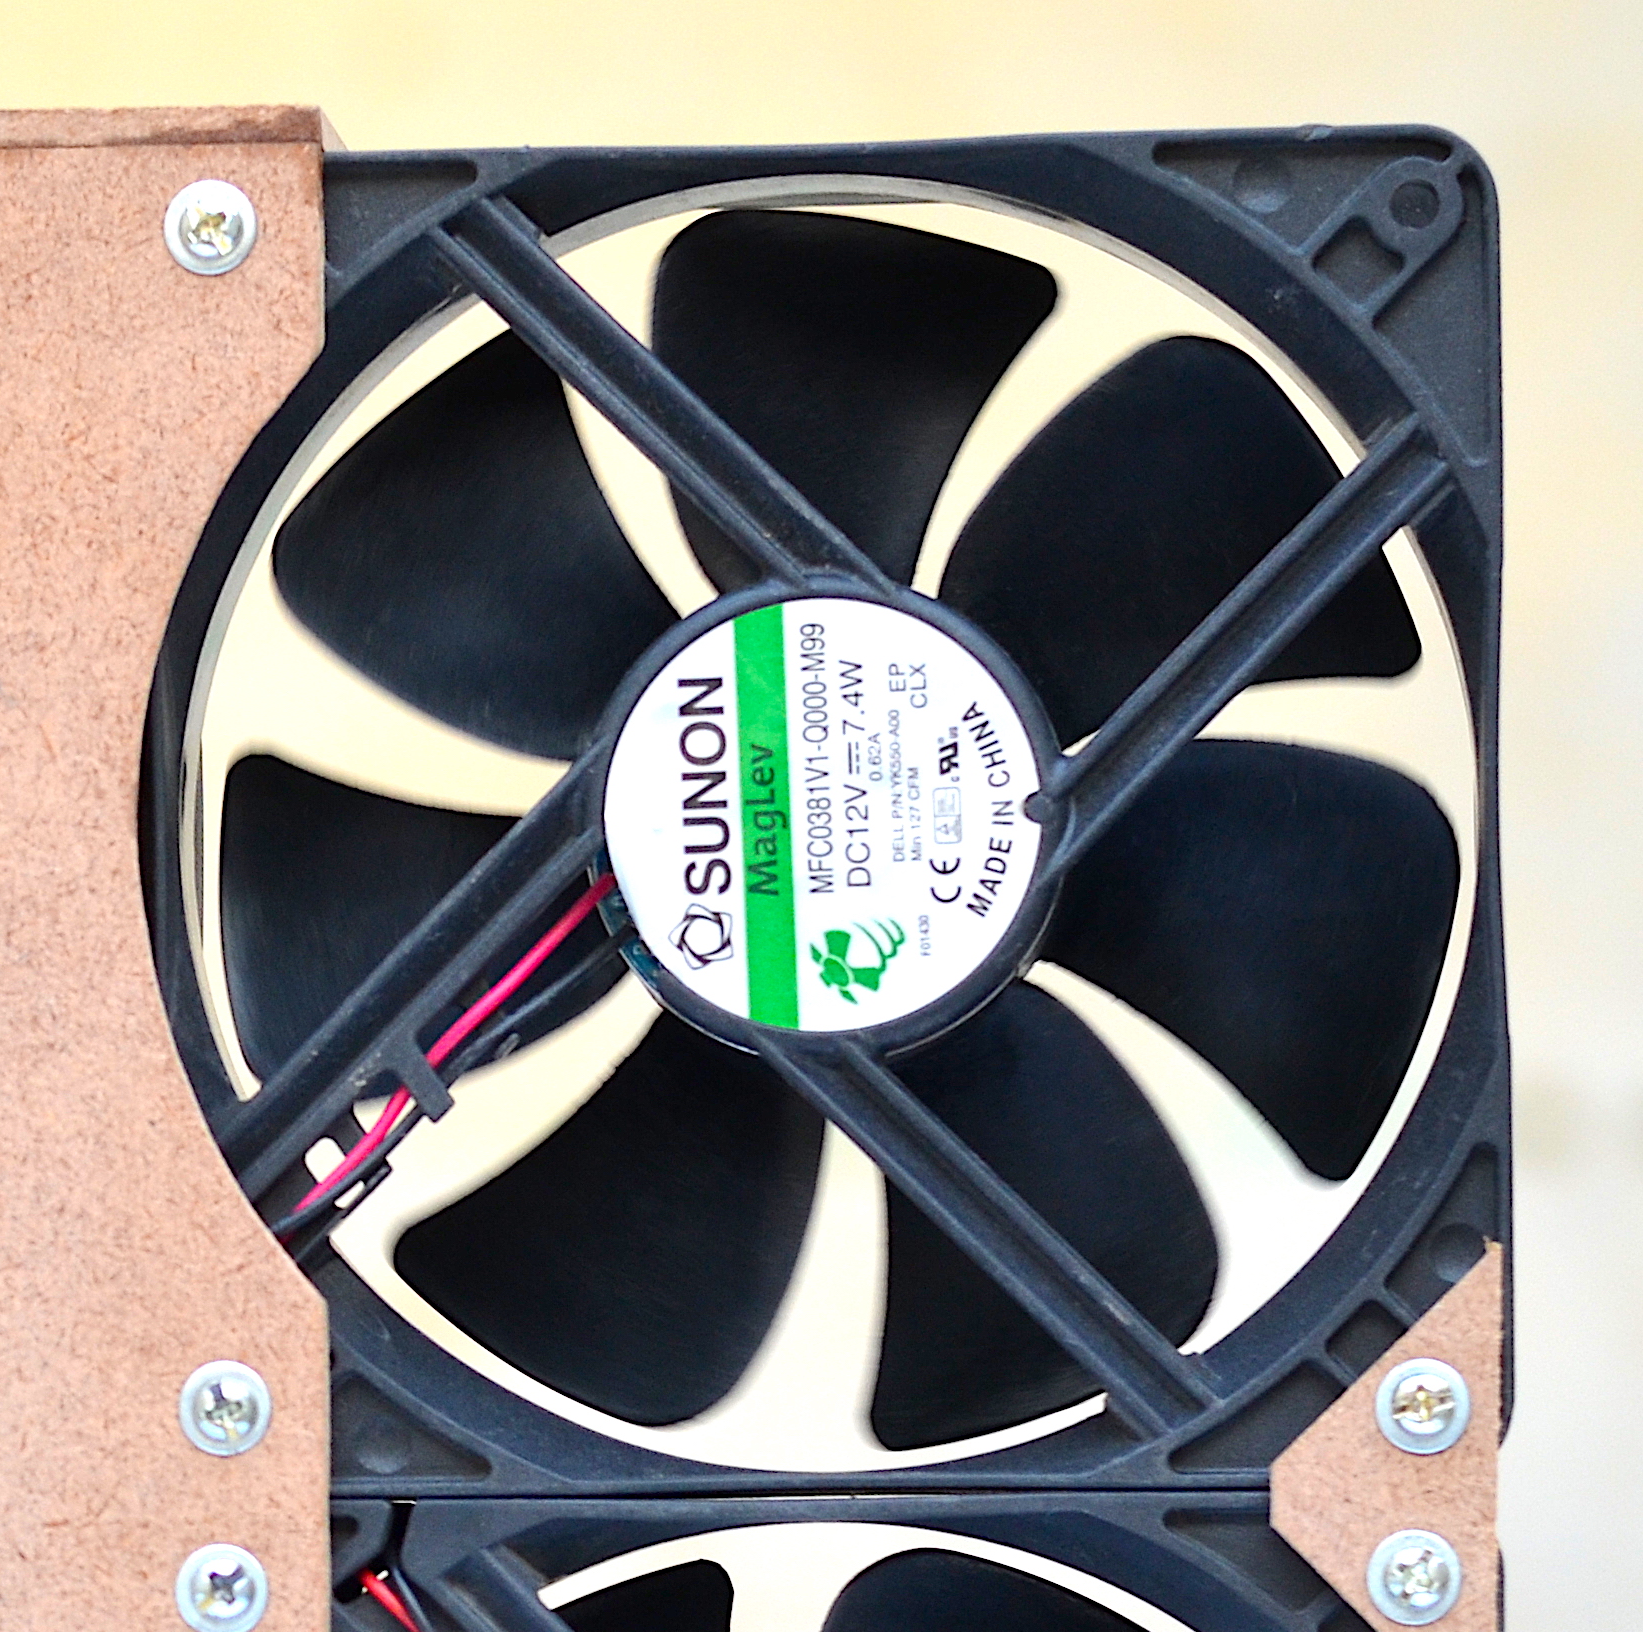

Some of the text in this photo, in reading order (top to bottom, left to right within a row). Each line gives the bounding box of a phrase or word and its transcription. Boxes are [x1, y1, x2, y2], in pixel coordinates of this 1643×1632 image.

[888, 663, 907, 692] EP
[908, 663, 927, 709] CLX
[677, 677, 732, 895] SUNON
[800, 623, 835, 894] MFC0381V1-Q000-M99
[868, 733, 883, 782] 0.62A
[745, 744, 787, 897] MagLev
[890, 824, 905, 862] DELL
[905, 767, 922, 862] Min 127 CFM
[959, 701, 1014, 918] MADE IN CHINA
